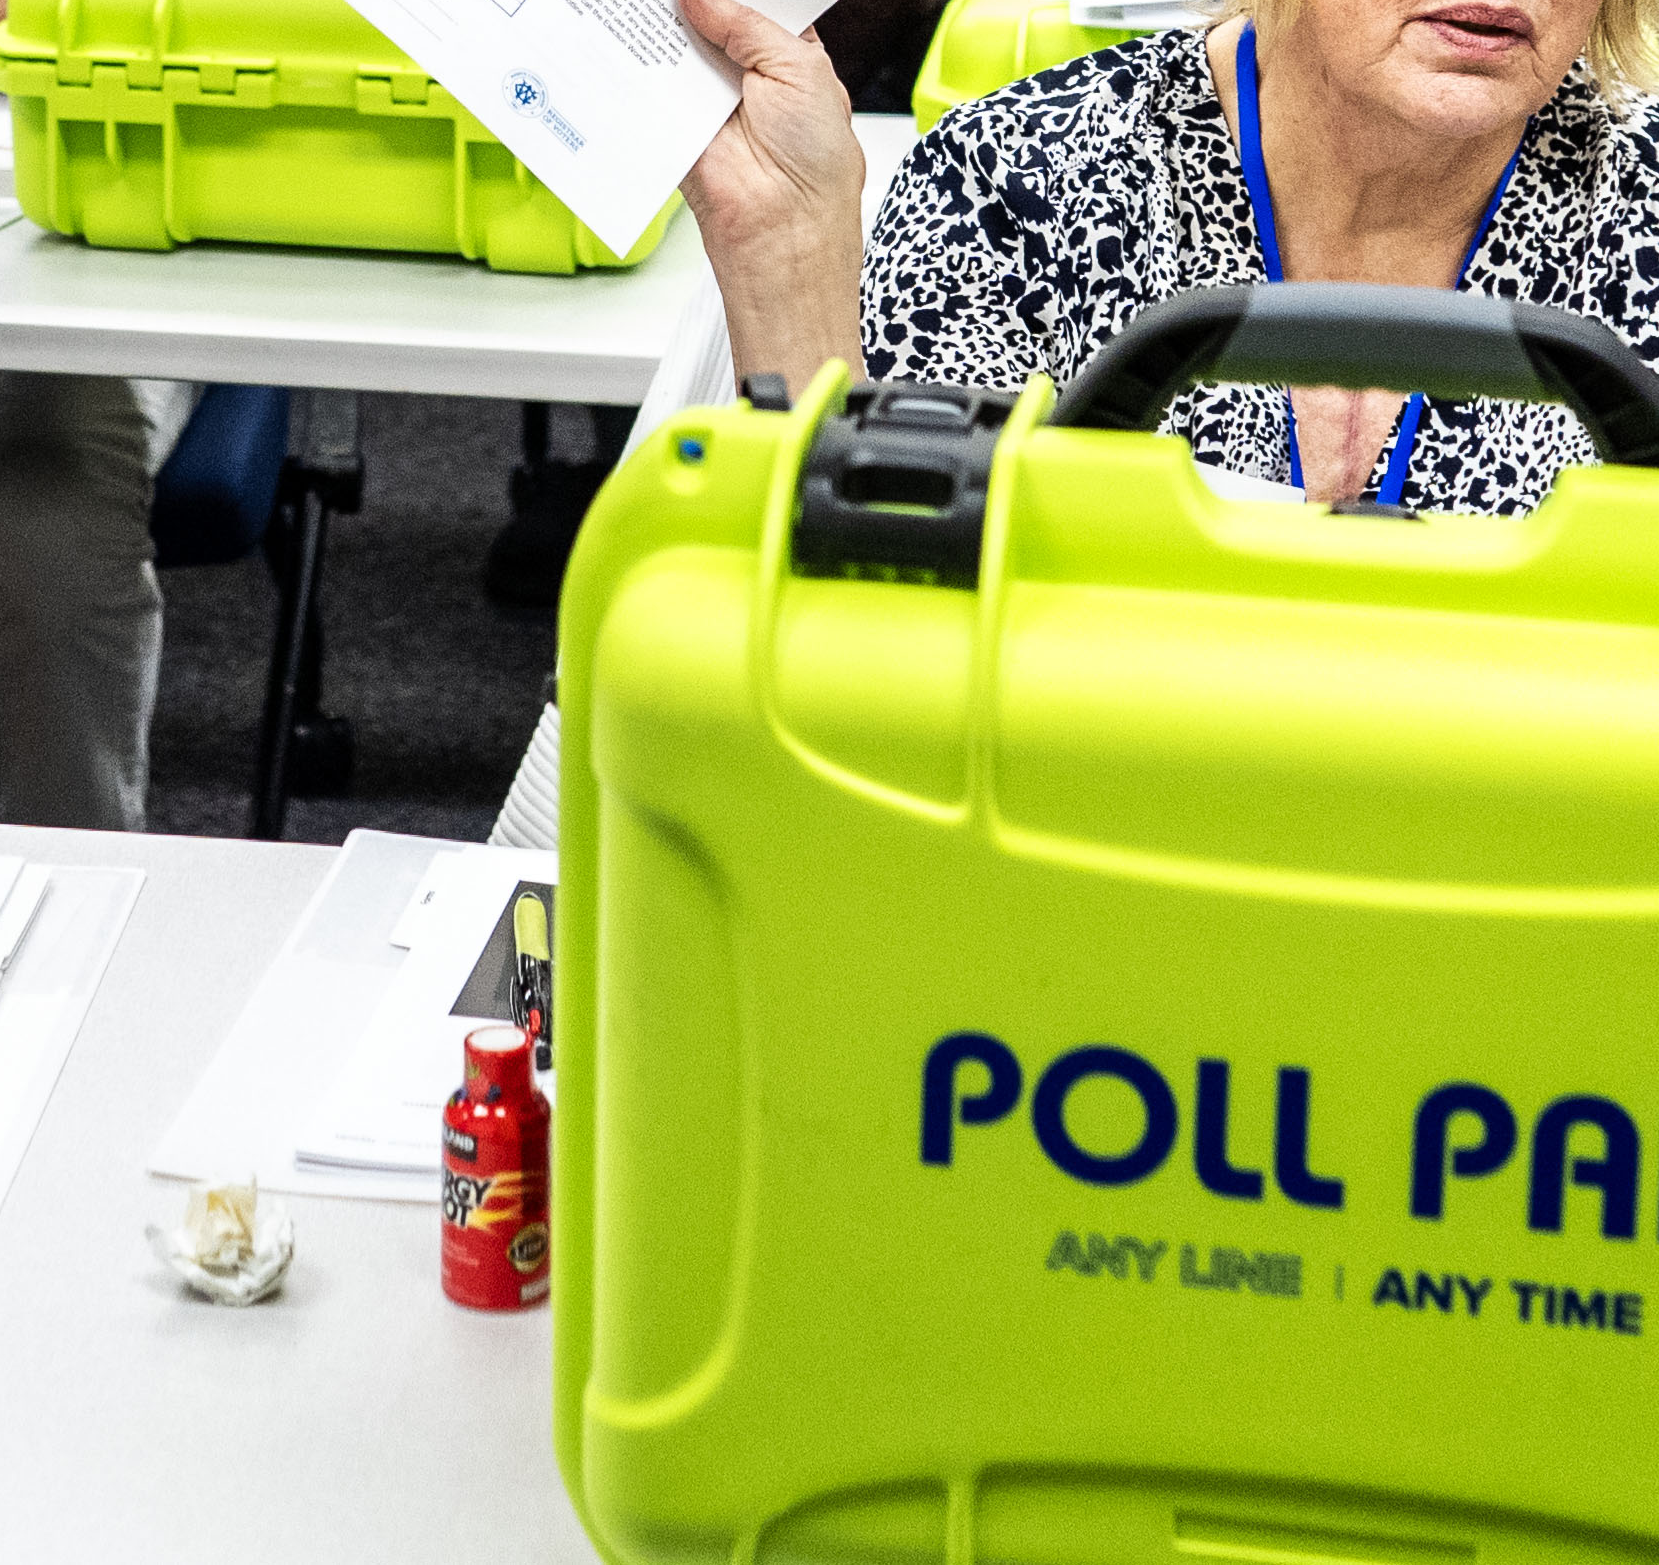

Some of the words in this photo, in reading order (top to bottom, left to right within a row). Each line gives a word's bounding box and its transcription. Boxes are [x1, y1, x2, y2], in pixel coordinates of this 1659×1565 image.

[921, 1032, 1345, 1210] POLL
[1046, 1231, 1164, 1283] ANY
[1180, 1245, 1303, 1298] LINE
[1374, 1269, 1491, 1317] ANY
[1512, 1281, 1643, 1336] TIME
